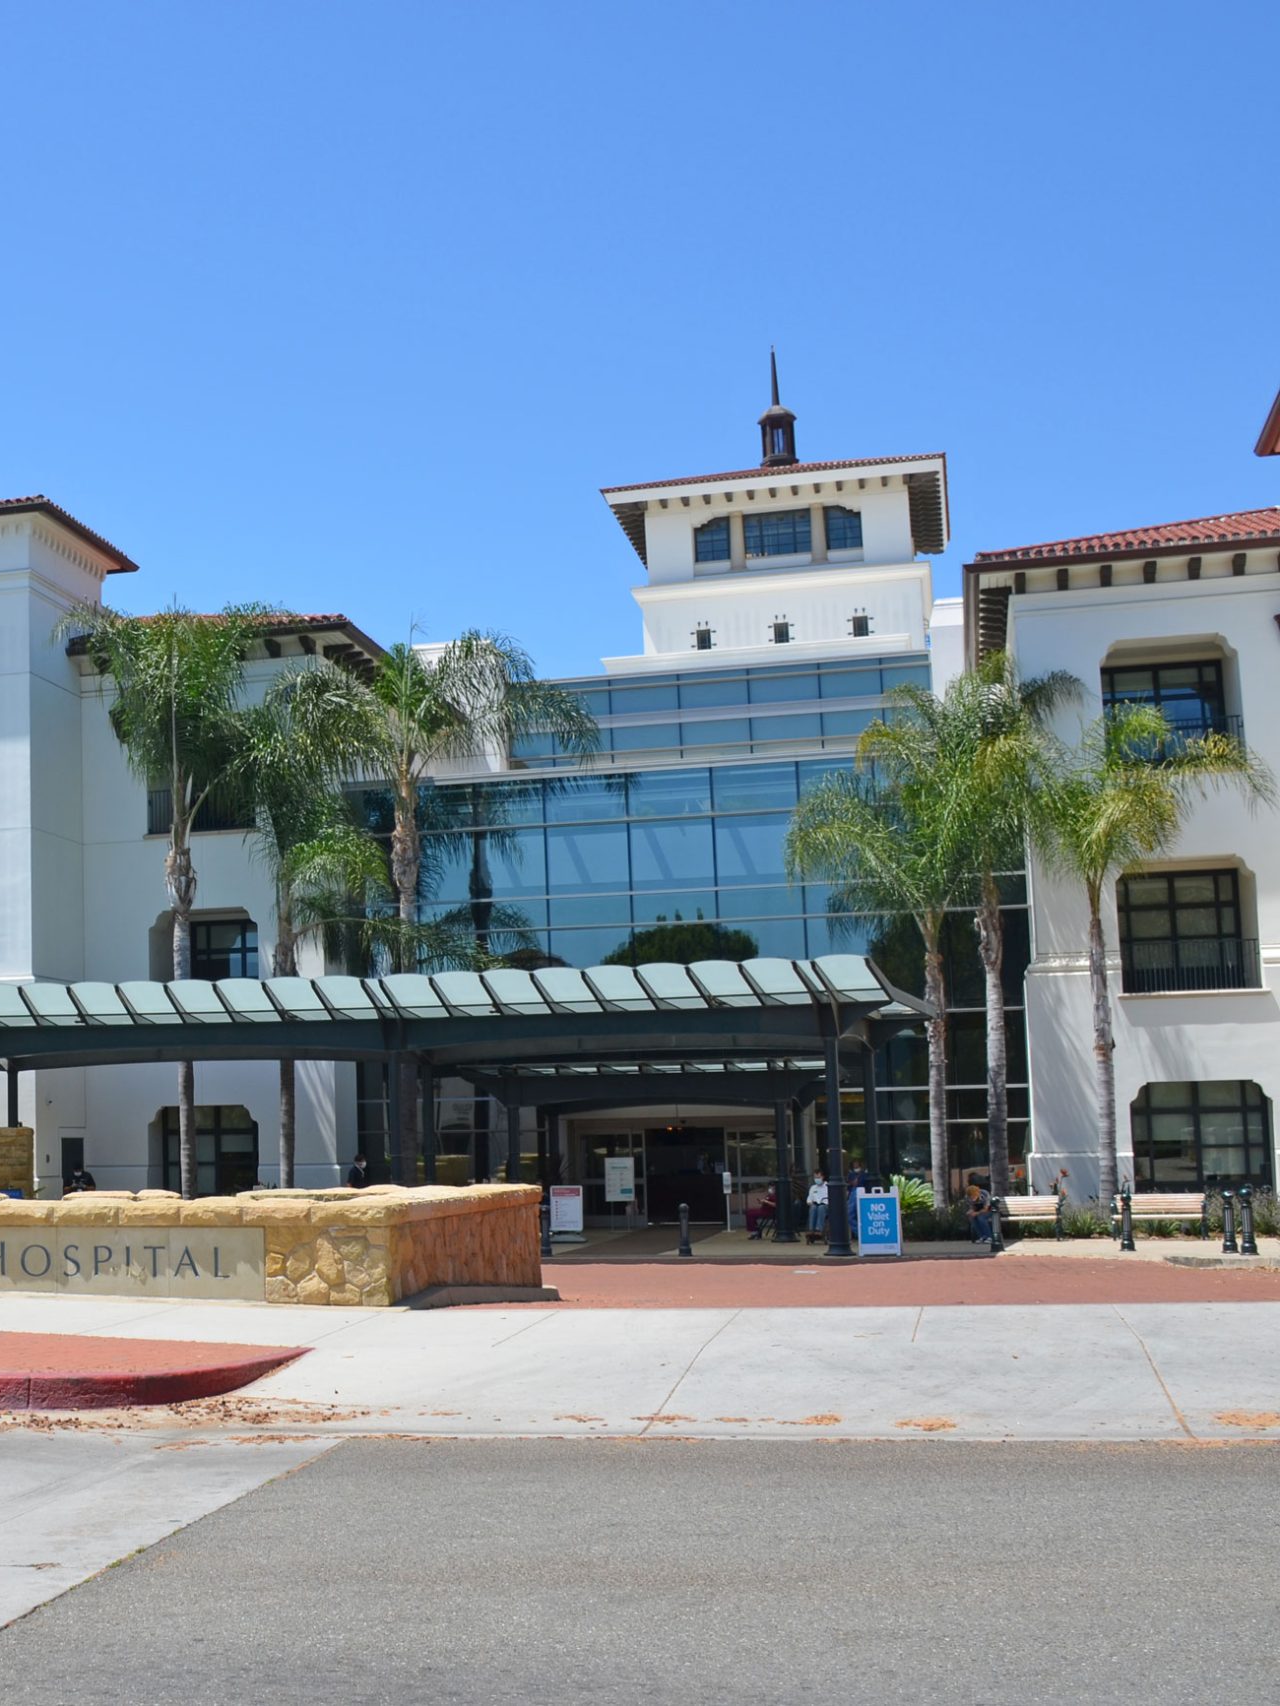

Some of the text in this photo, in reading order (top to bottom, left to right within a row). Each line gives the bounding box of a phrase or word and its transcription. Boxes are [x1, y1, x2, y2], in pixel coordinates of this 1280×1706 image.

[870, 1203, 886, 1212] NO
[867, 1212, 890, 1220] Valet
[868, 1227, 890, 1237] Duty
